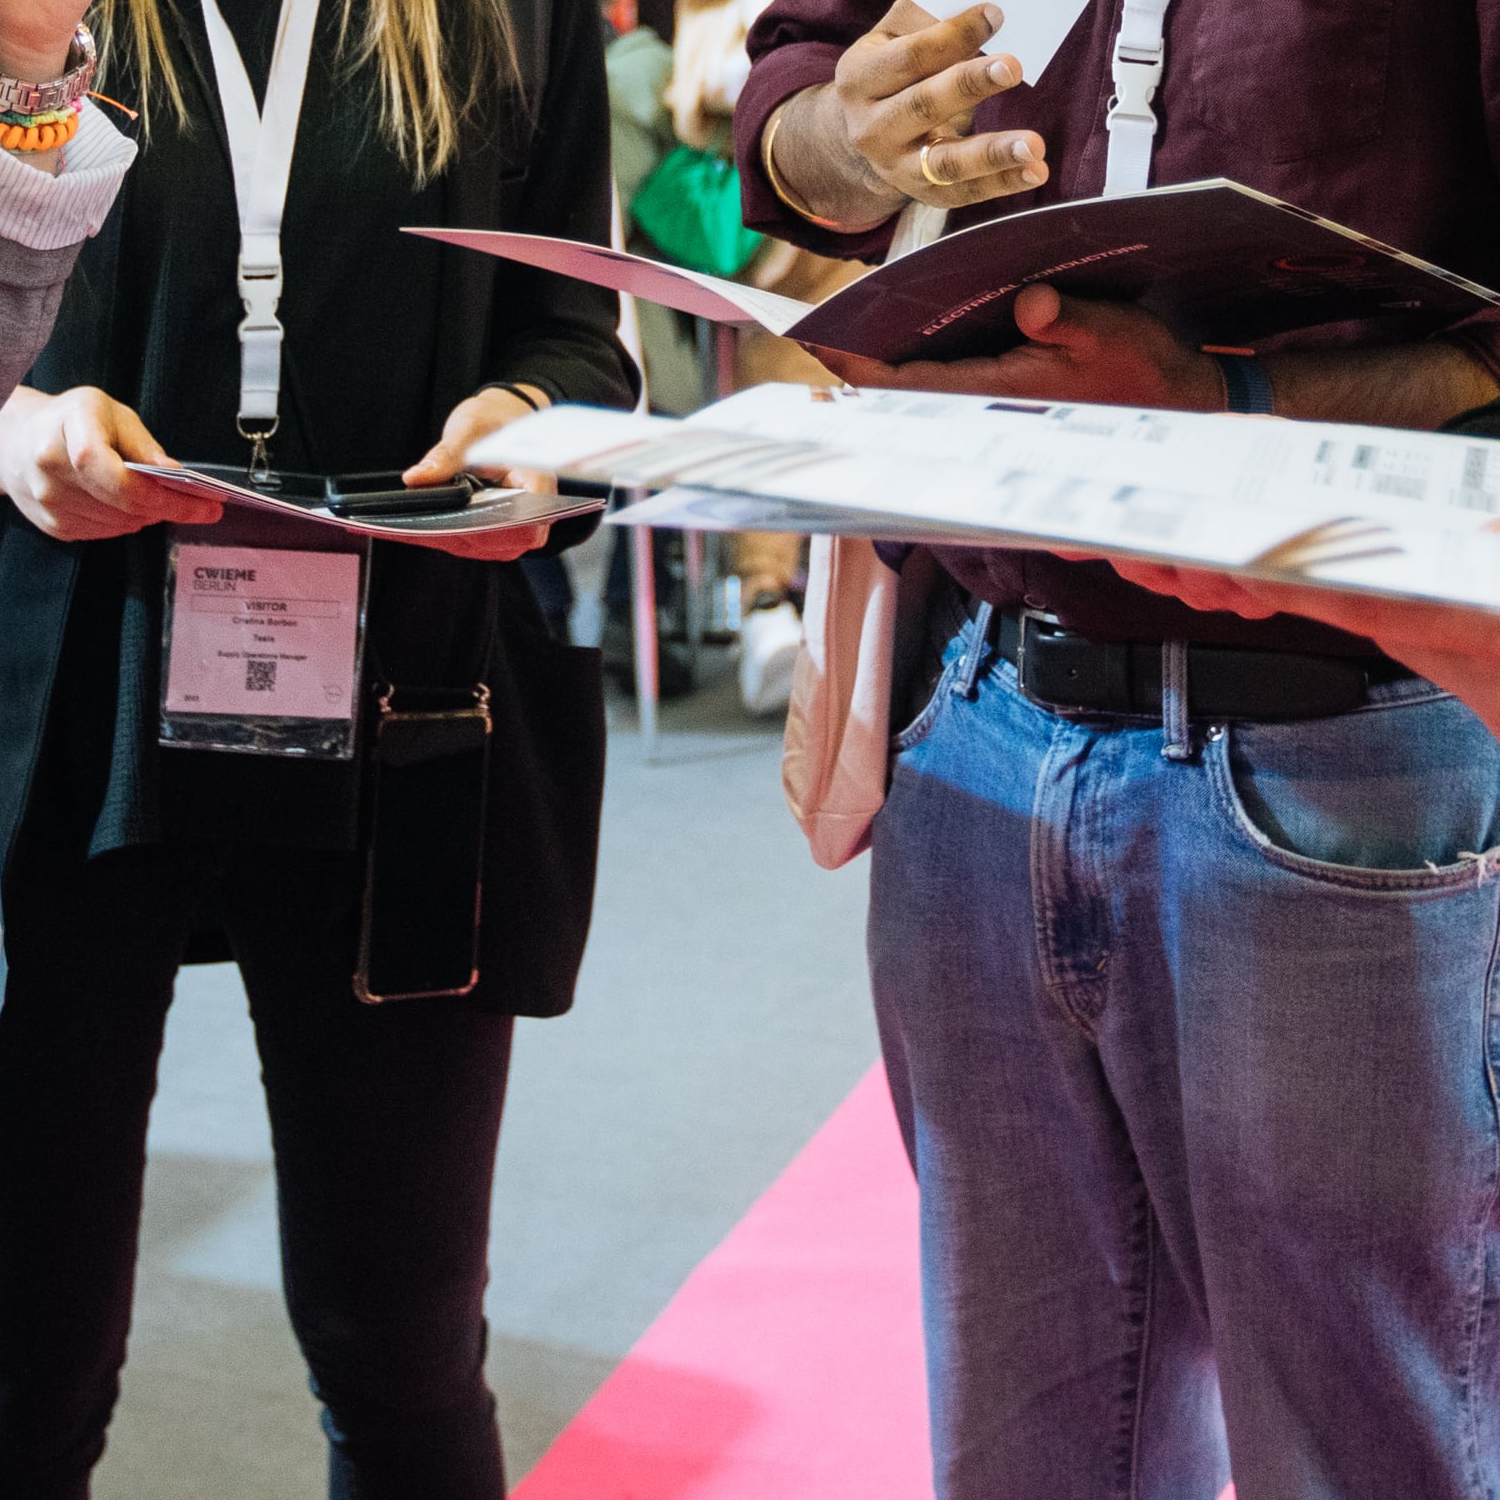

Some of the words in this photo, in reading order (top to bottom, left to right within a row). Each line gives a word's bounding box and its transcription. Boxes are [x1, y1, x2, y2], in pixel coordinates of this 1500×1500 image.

[922, 283, 1021, 336] ELECTRICAL
[1023, 243, 1148, 282] CONDUCTORS
[194, 567, 256, 582] CWIEME
[193, 580, 236, 591] BERLIN
[245, 602, 287, 611] VISITOR
